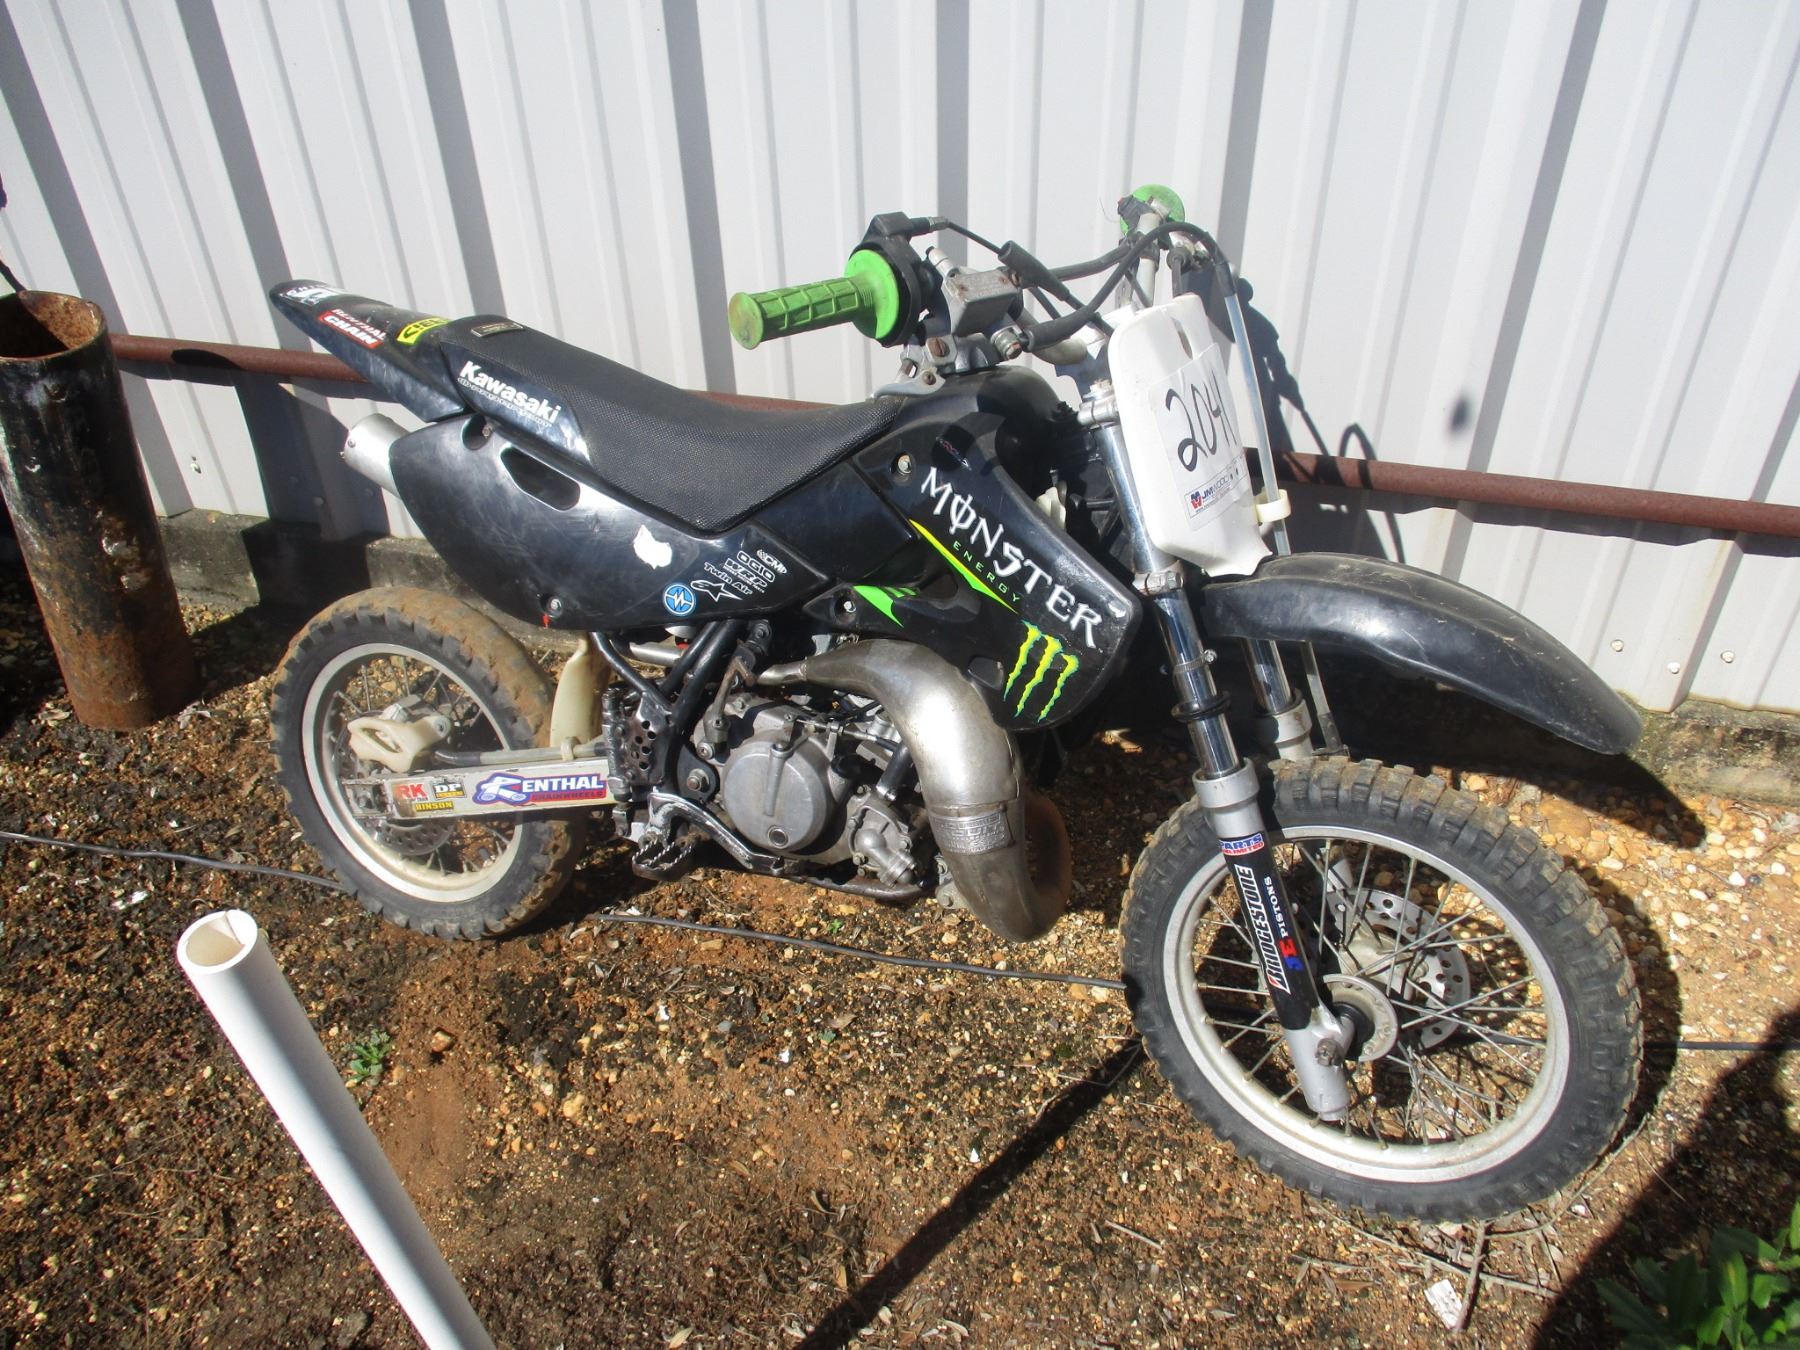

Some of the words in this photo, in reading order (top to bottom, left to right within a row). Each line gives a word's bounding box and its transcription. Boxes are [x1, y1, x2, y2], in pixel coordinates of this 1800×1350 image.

[460, 361, 561, 424] Kawasaki
[704, 562, 732, 584] Twin
[731, 582, 753, 594] Air
[723, 558, 767, 587] WRP
[737, 550, 775, 582] OGIO
[921, 467, 1102, 648] MONSTER
[953, 541, 1020, 602] ENERGY
[395, 784, 427, 800] RK
[1234, 864, 1291, 994] BRIDGESTONE
[1264, 876, 1288, 938] PISTONS
